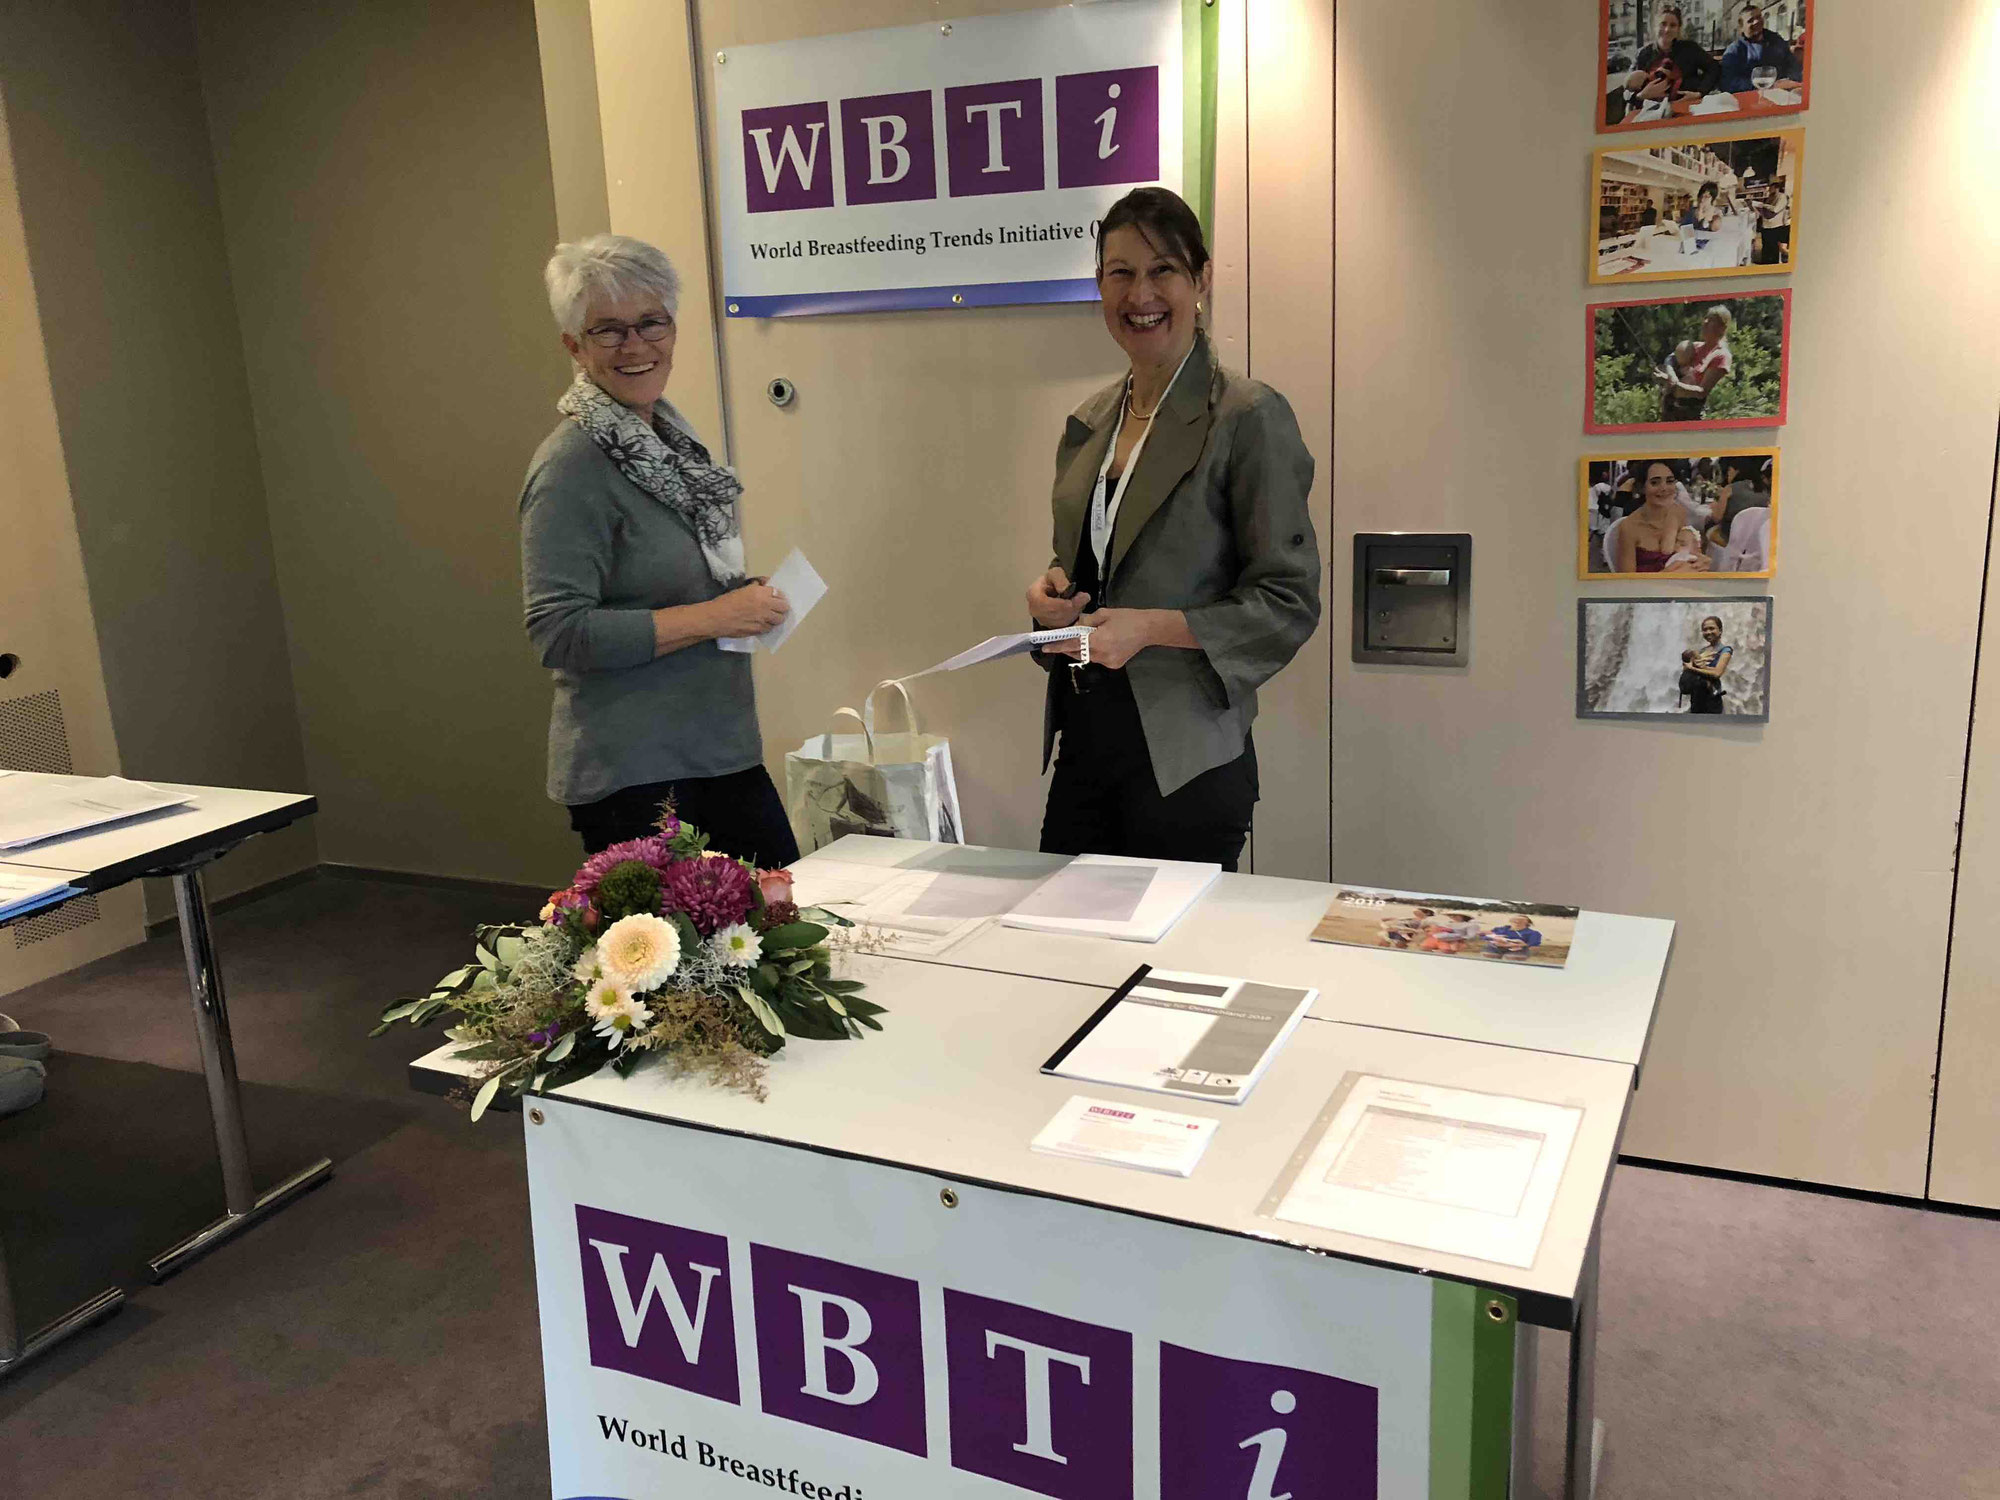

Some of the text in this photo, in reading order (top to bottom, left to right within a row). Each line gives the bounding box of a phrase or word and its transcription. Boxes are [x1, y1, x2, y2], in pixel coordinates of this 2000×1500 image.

[750, 241, 803, 260] World
[807, 234, 926, 255] Breastfeeding
[930, 228, 994, 248] Trends
[999, 222, 1084, 244] Initiative
[597, 1414, 688, 1461] World
